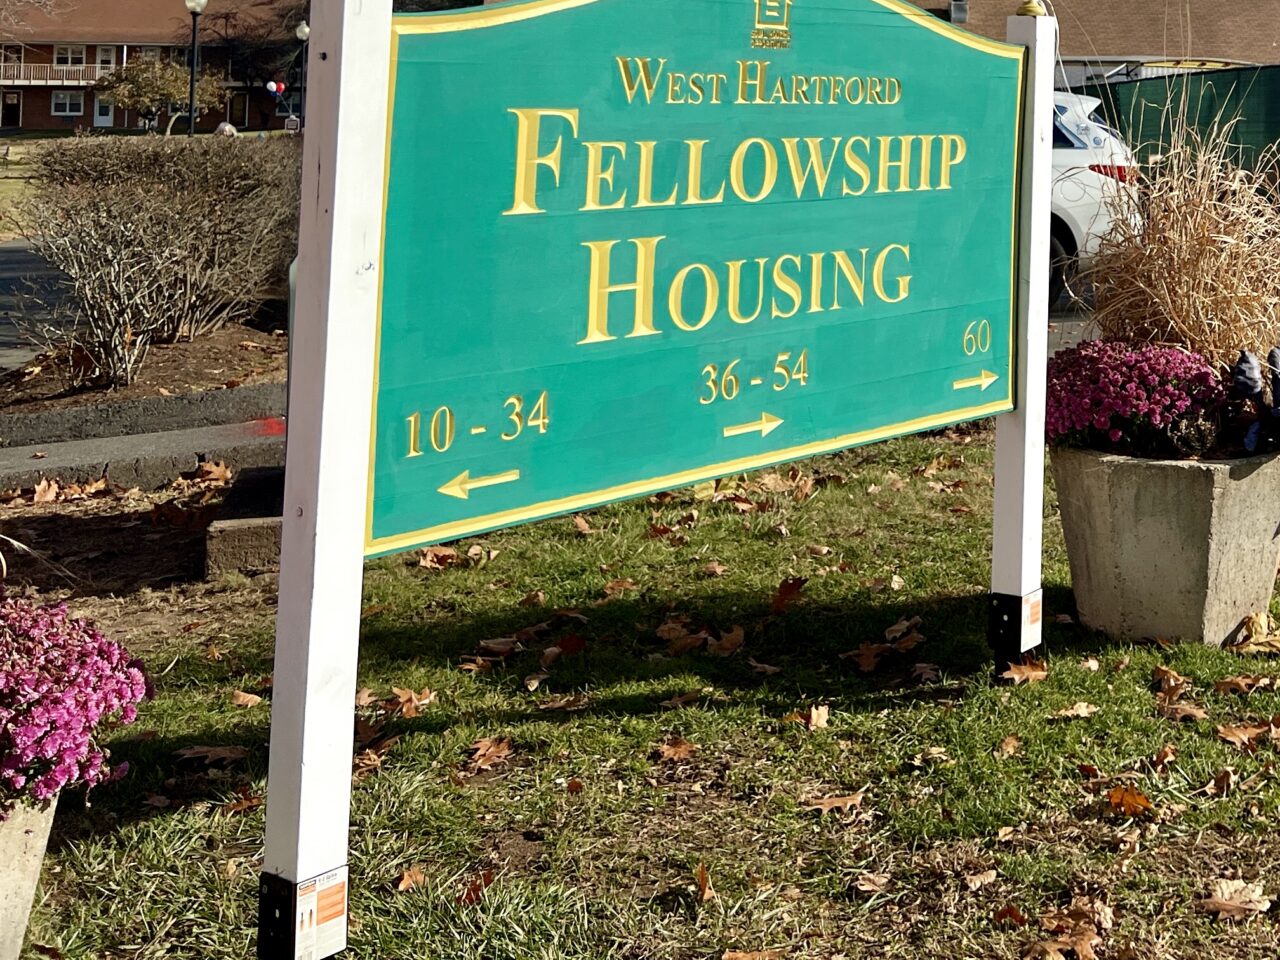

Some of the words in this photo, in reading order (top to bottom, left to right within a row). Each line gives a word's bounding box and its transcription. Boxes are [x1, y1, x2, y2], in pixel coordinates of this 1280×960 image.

[615, 55, 728, 105] WEST
[734, 59, 903, 105] HARTFORD
[502, 107, 968, 217] FELLOWSHIP
[577, 234, 913, 346] HOUSING
[962, 319, 993, 356] 60
[698, 358, 741, 405] 36
[771, 348, 810, 392] 54
[405, 405, 456, 458] 10
[501, 390, 550, 441] 34
